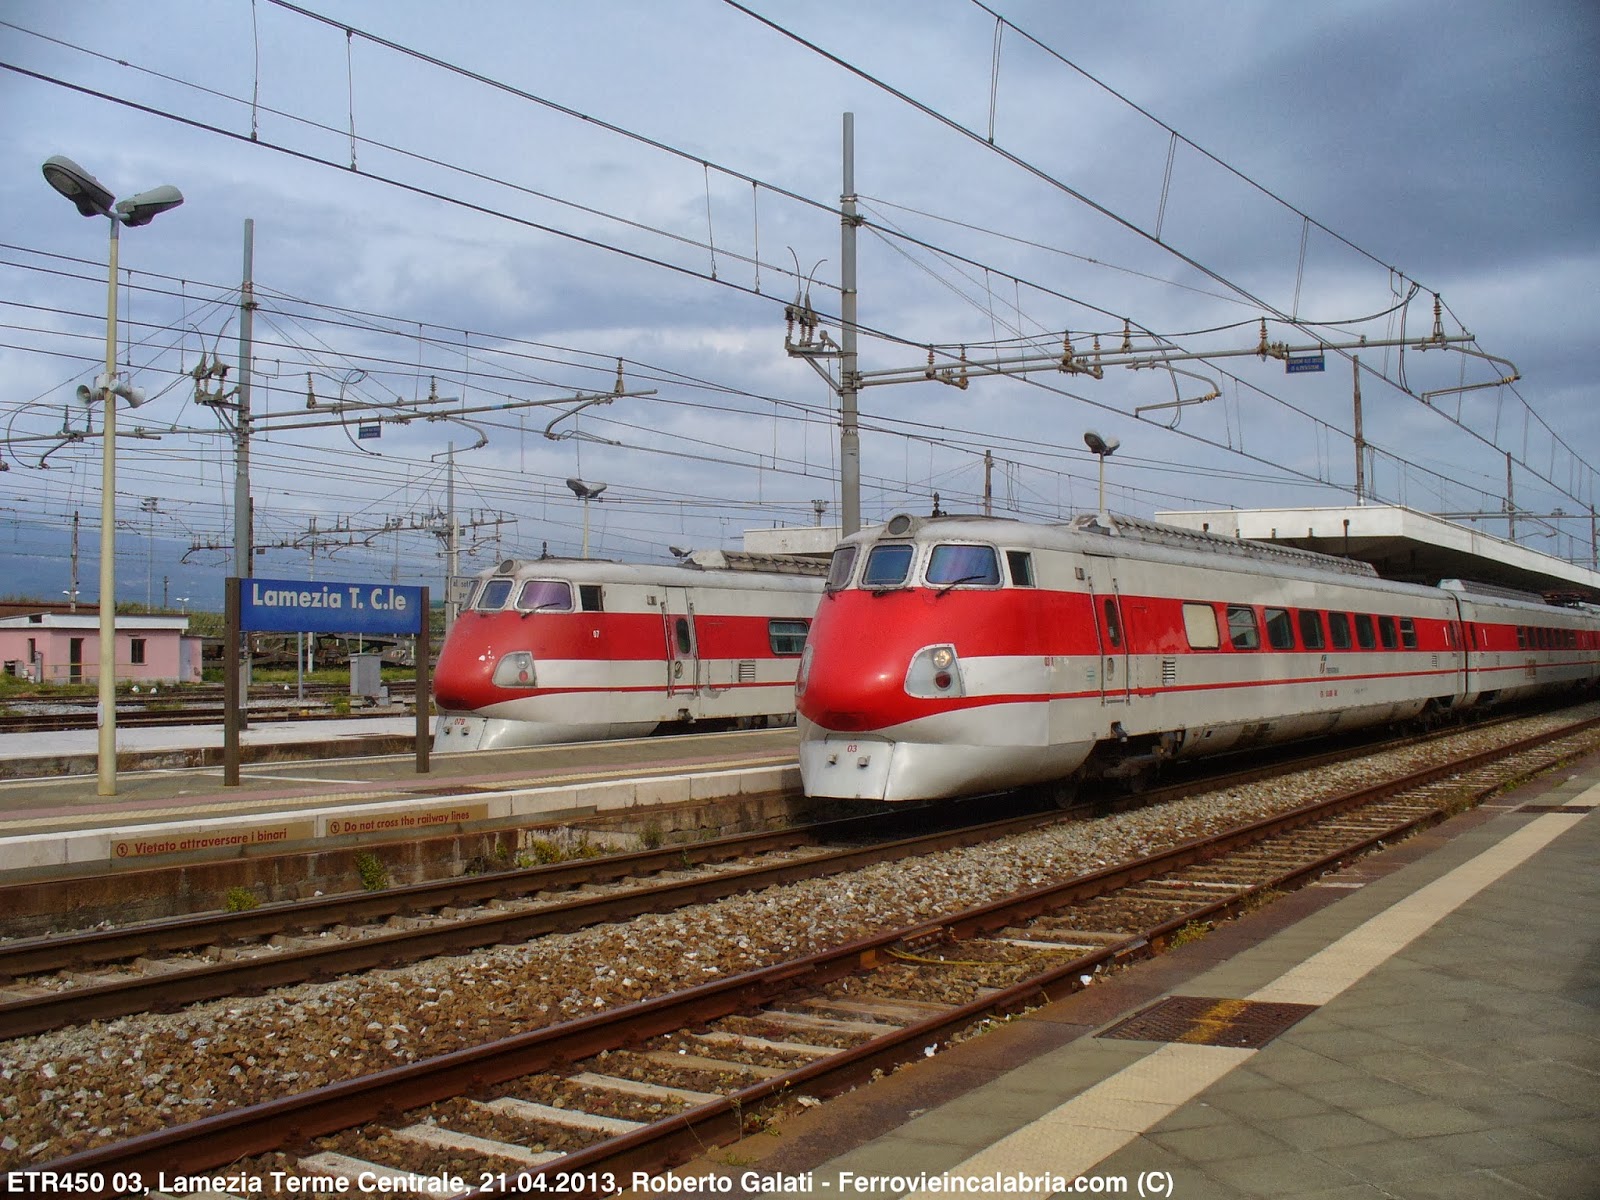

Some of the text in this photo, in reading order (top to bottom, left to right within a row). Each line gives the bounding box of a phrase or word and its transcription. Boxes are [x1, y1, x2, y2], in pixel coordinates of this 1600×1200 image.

[252, 583, 407, 610] Lamezia T. C.le
[847, 744, 858, 753] 03
[344, 810, 470, 832] Do not cross the railway lines
[134, 842, 177, 854] Vietato
[180, 834, 249, 850] attraversare
[257, 828, 287, 841] binari
